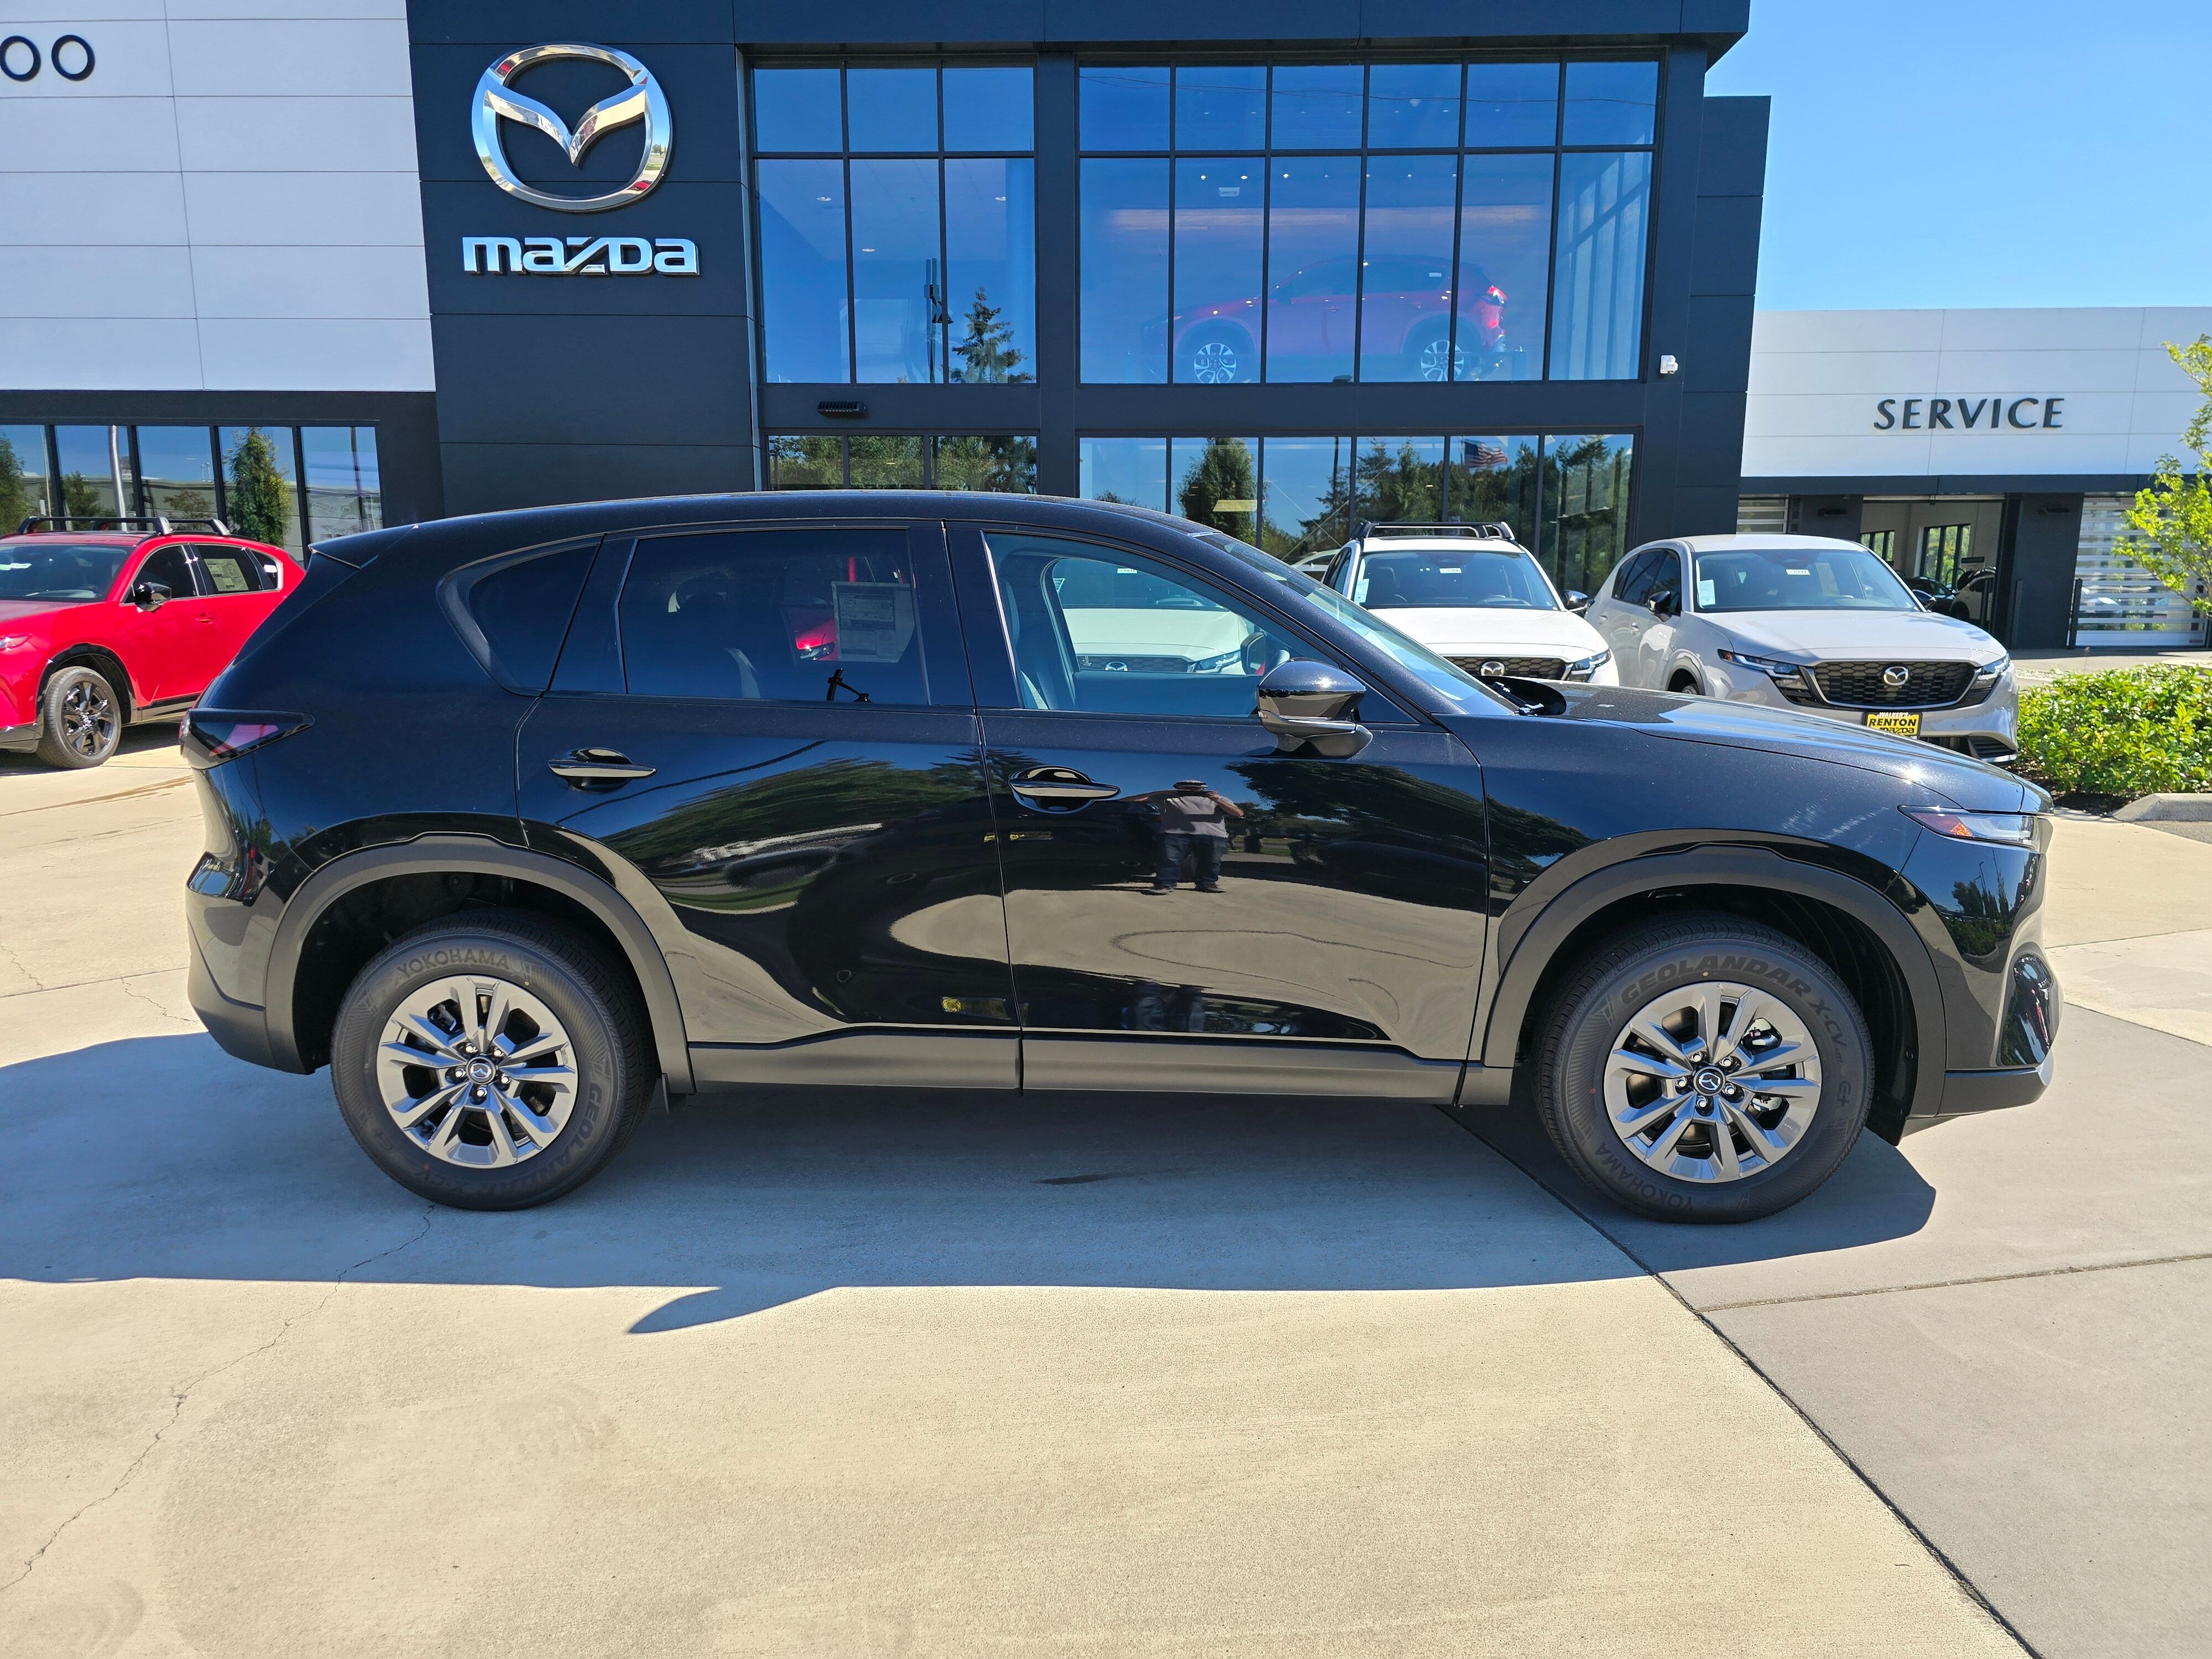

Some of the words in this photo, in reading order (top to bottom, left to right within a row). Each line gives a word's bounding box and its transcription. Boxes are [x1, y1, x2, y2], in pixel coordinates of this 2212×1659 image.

[1874, 398, 2065, 430] SERVICE
[1869, 718, 1917, 727] RENTON
[397, 948, 510, 978] YOKOHAMA
[1620, 955, 1813, 1005] GEOLANDAR
[1808, 999, 1848, 1048] X-CV
[1595, 1142, 1694, 1209] YOKOHAMA
